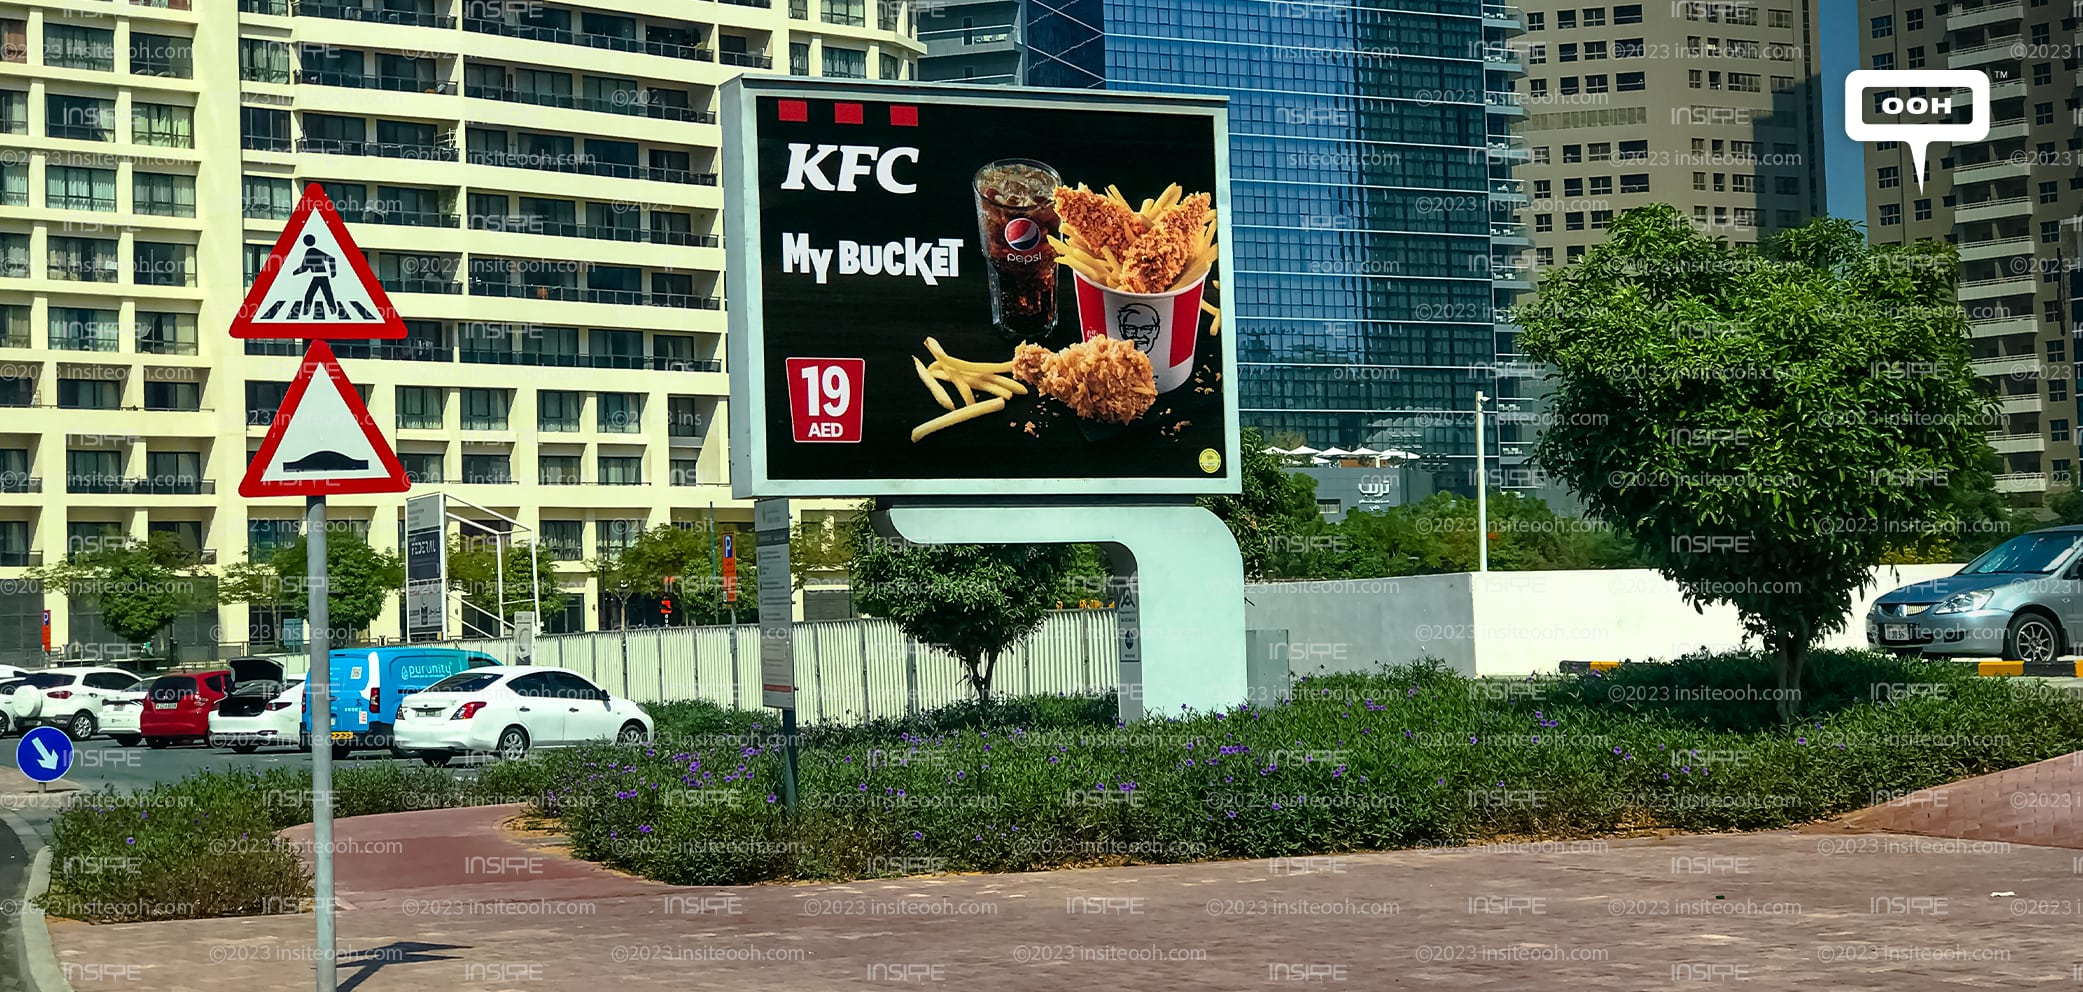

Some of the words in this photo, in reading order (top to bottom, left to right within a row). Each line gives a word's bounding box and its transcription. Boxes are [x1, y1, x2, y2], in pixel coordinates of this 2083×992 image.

[780, 143, 920, 194] KFC
[838, 237, 964, 286] BUCKET
[1006, 251, 1042, 265] pepsi
[801, 365, 851, 417] 19
[808, 422, 844, 438] AED
[410, 539, 437, 556] FEDERAL
[725, 535, 732, 558] P
[408, 663, 452, 677] purunity
